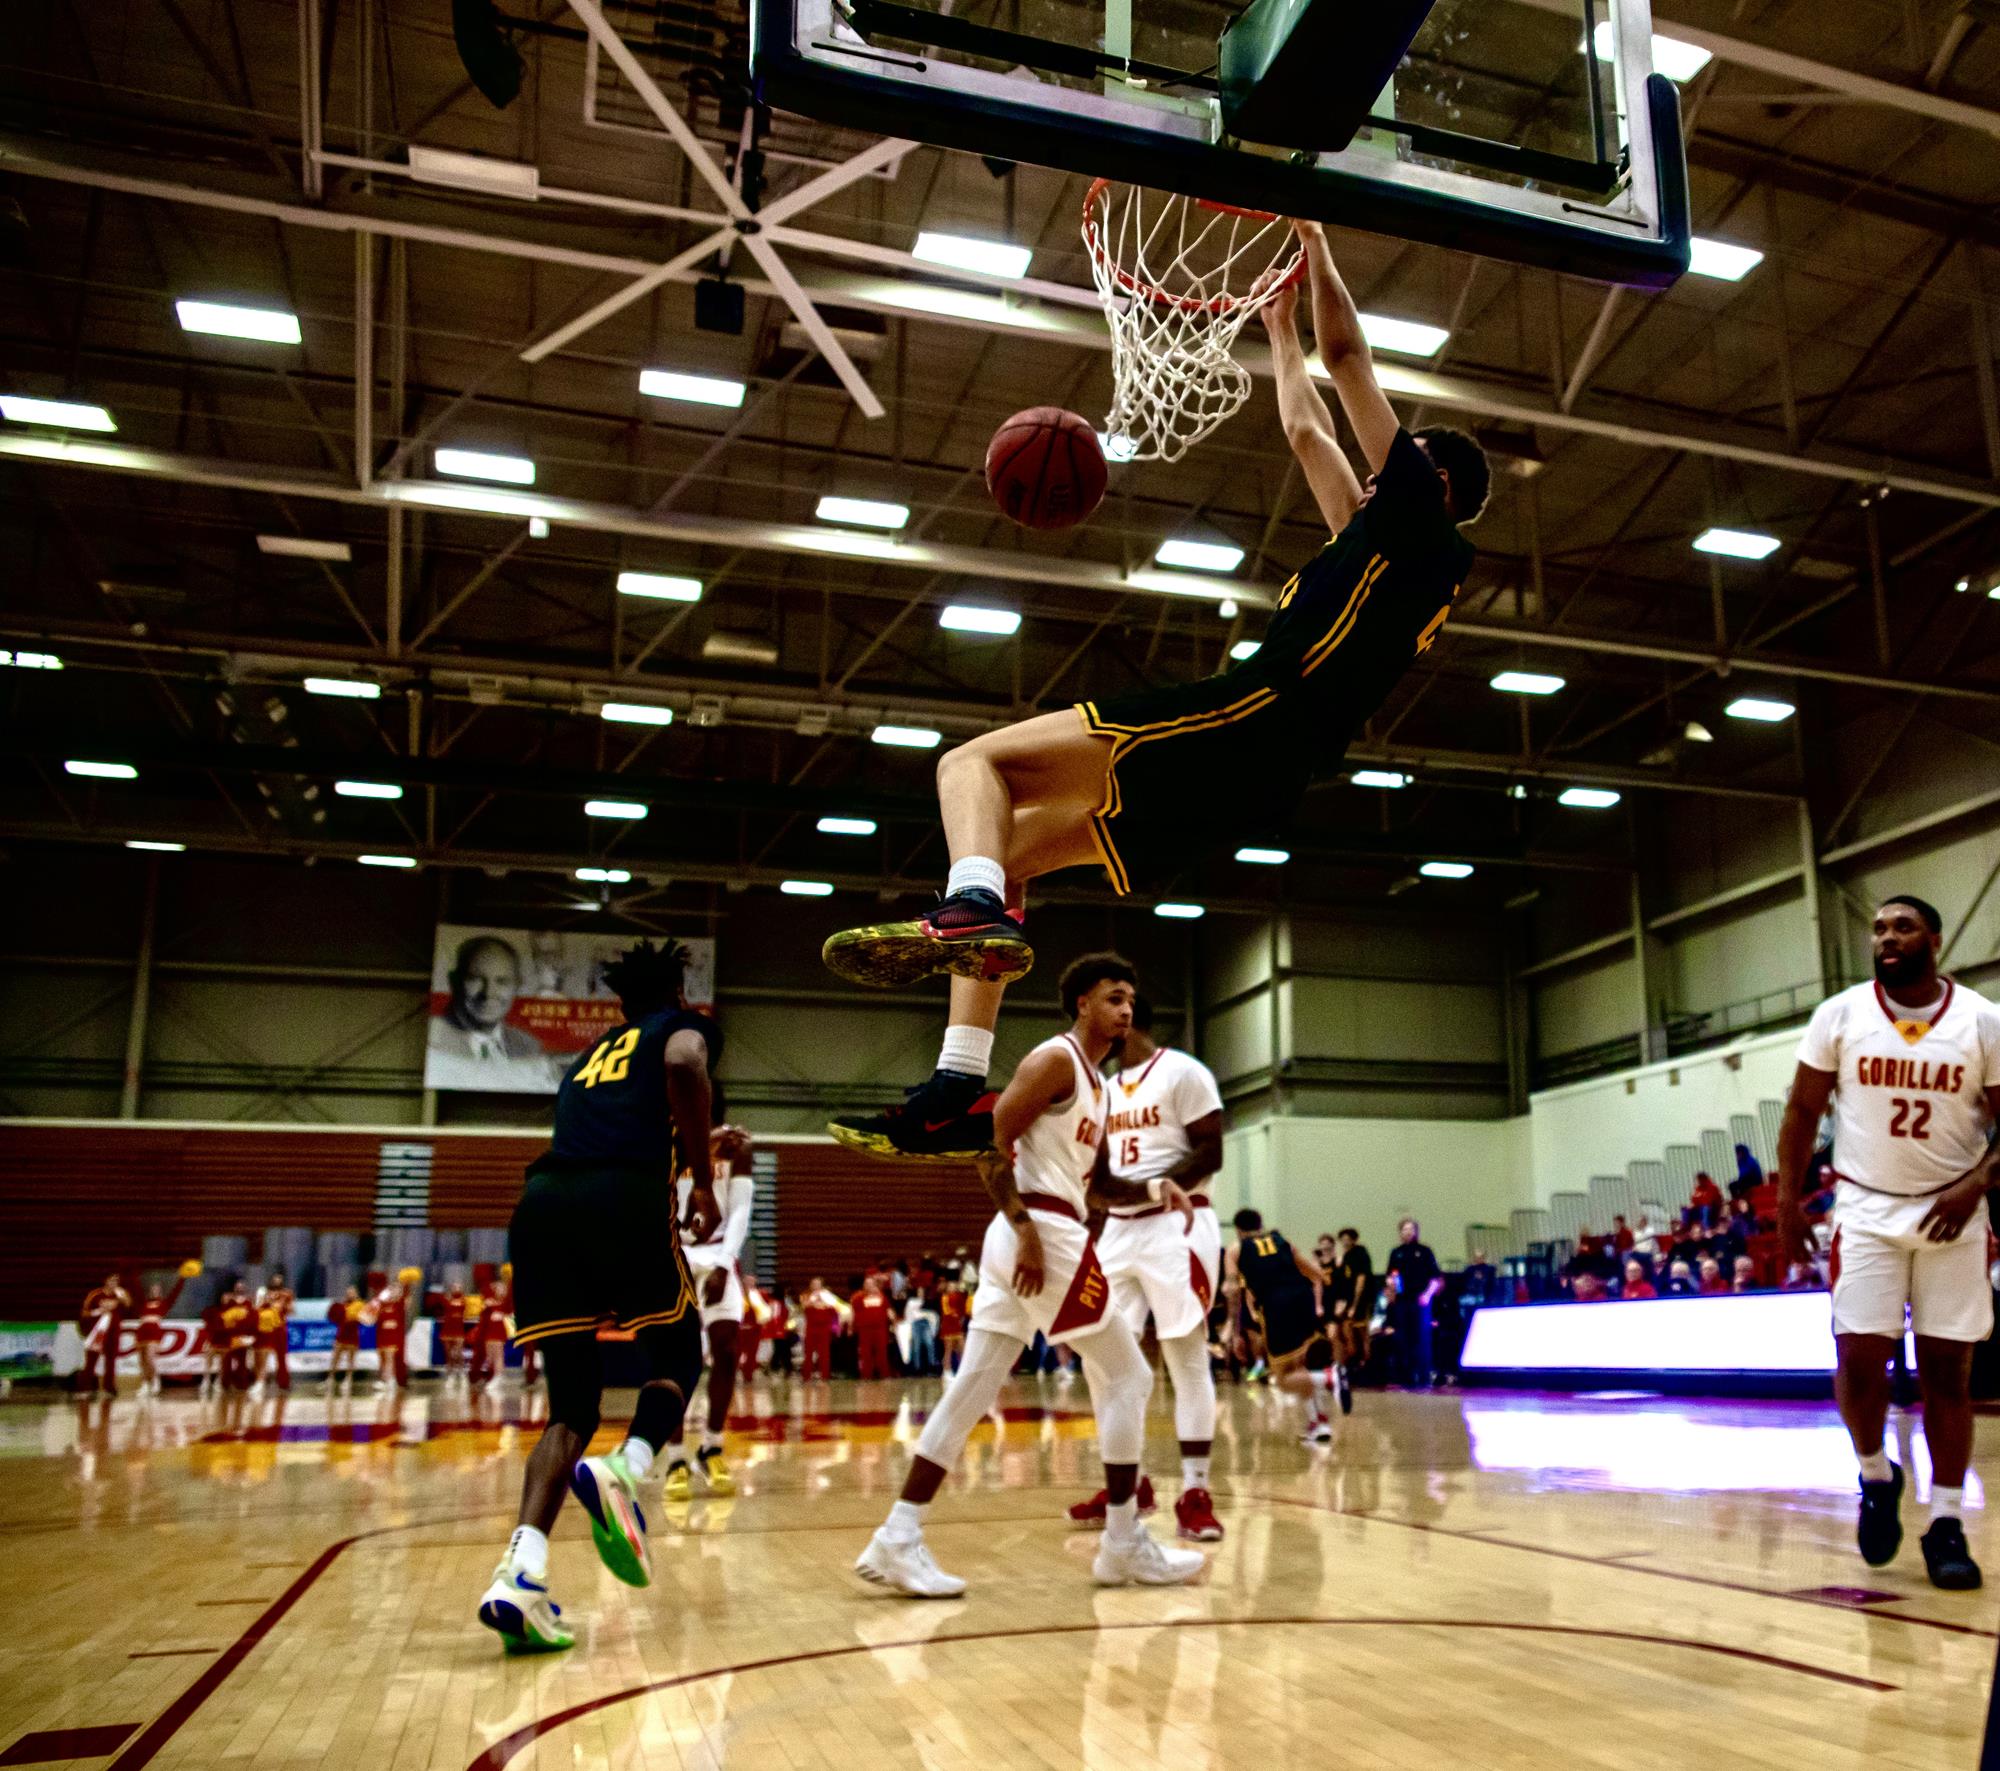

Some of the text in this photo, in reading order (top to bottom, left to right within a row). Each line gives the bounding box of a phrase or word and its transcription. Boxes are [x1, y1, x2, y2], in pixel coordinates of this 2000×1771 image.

[573, 1028, 641, 1088] 42
[1858, 1056, 1965, 1093] GORILLAS
[1890, 1098, 1932, 1140] 22
[1120, 1137, 1140, 1167] 15
[1254, 1236, 1277, 1257] 11
